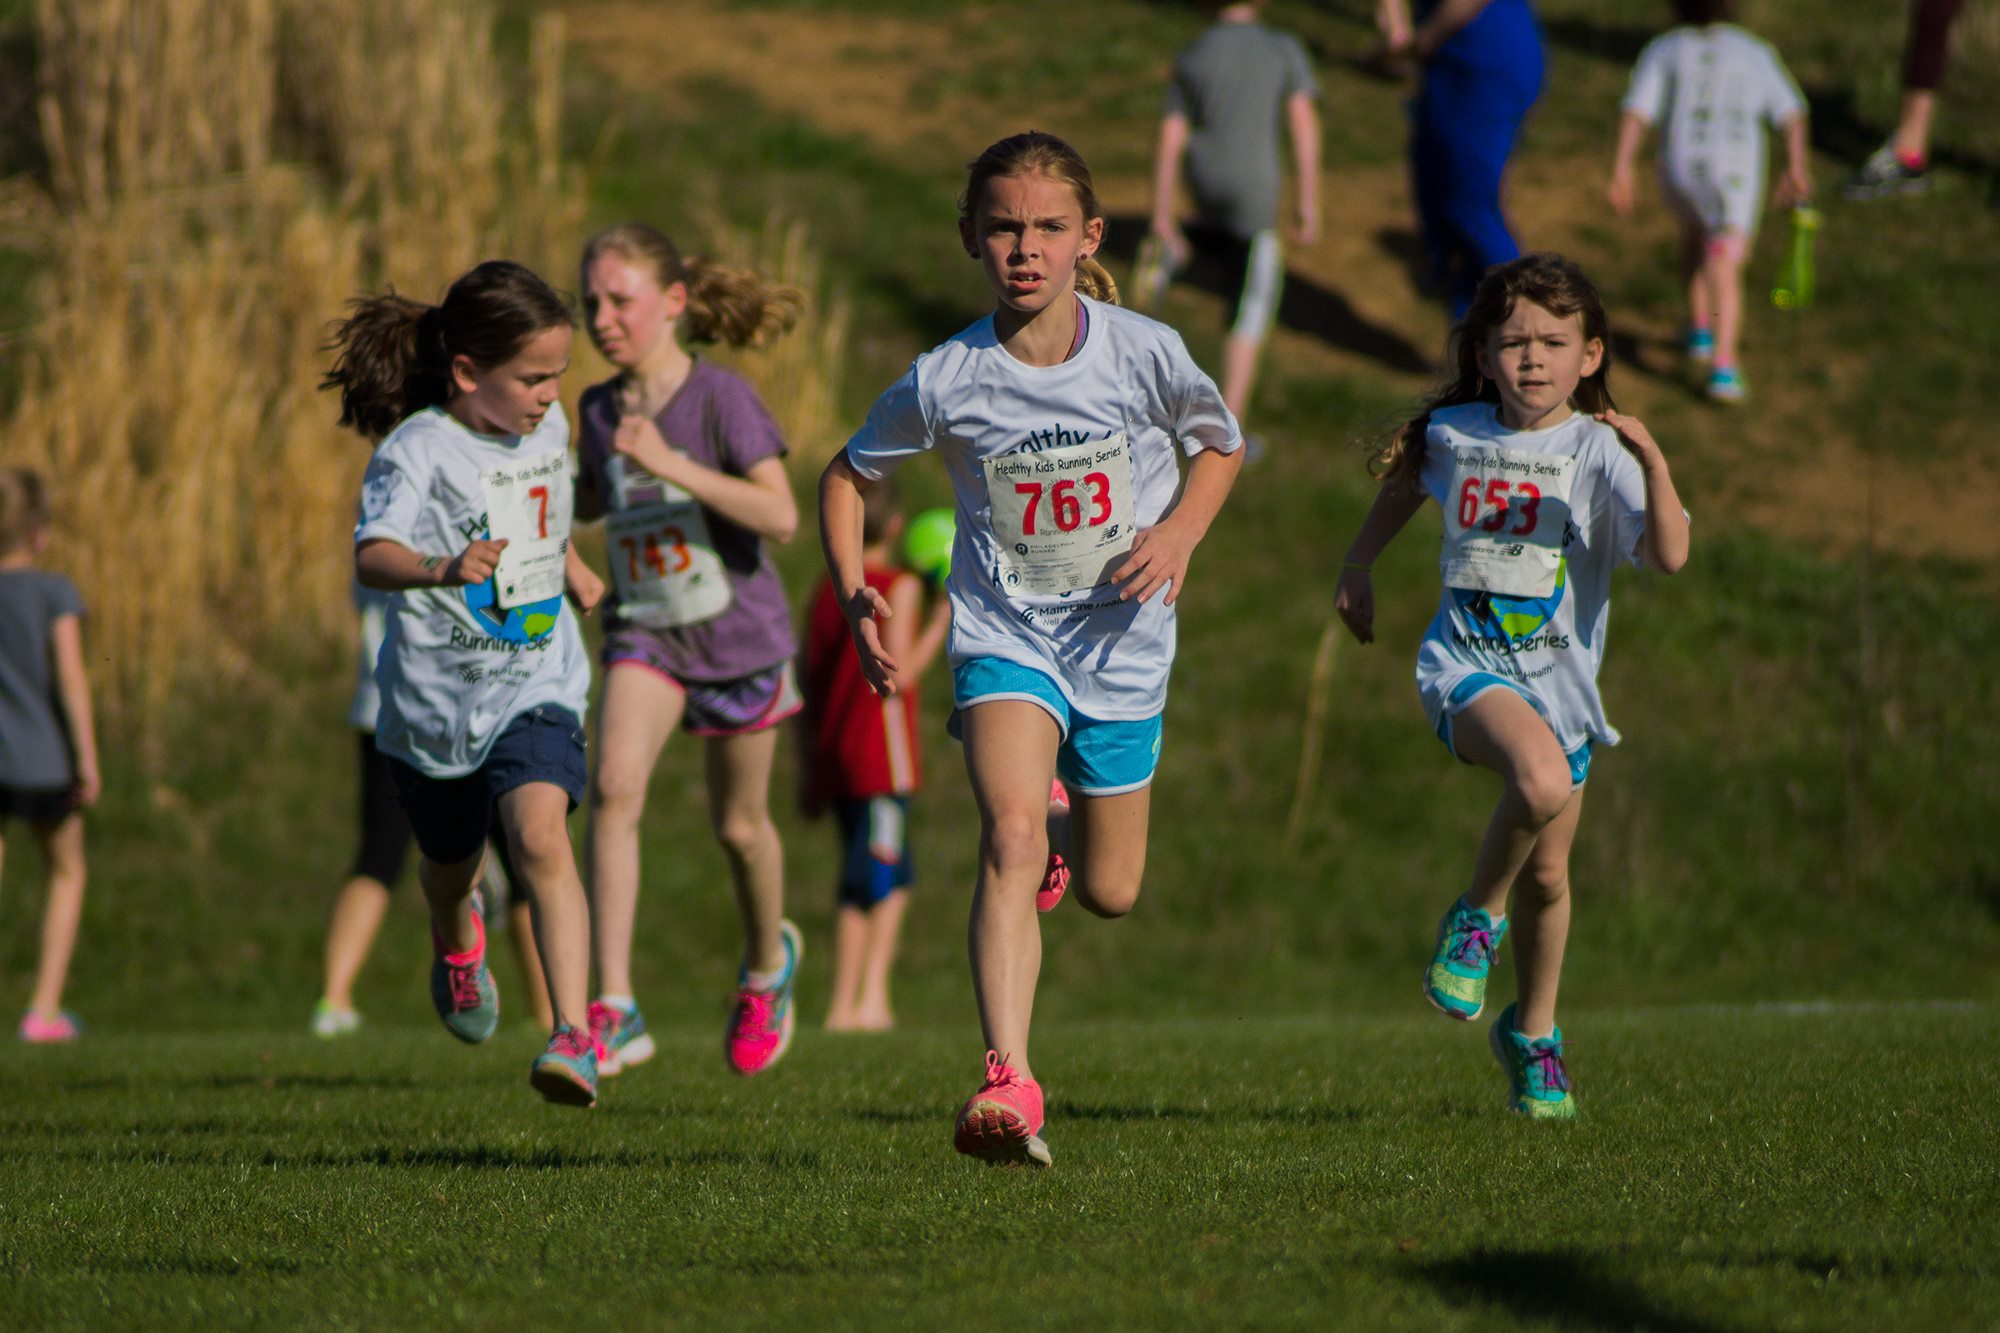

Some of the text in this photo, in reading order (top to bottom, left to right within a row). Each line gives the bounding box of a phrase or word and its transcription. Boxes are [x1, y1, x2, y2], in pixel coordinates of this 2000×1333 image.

[996, 446, 1121, 477] Healthy Kids Running Series
[1455, 454, 1561, 477] Healthy Kids Running Series
[528, 485, 549, 539] 7
[1014, 472, 1112, 536] 763
[1458, 476, 1541, 537] 653
[618, 526, 692, 583] 743
[1039, 605, 1067, 617] Main
[1069, 601, 1094, 612] Line
[450, 626, 521, 658] Running
[1511, 629, 1570, 653] Series
[1524, 665, 1553, 680] Health
